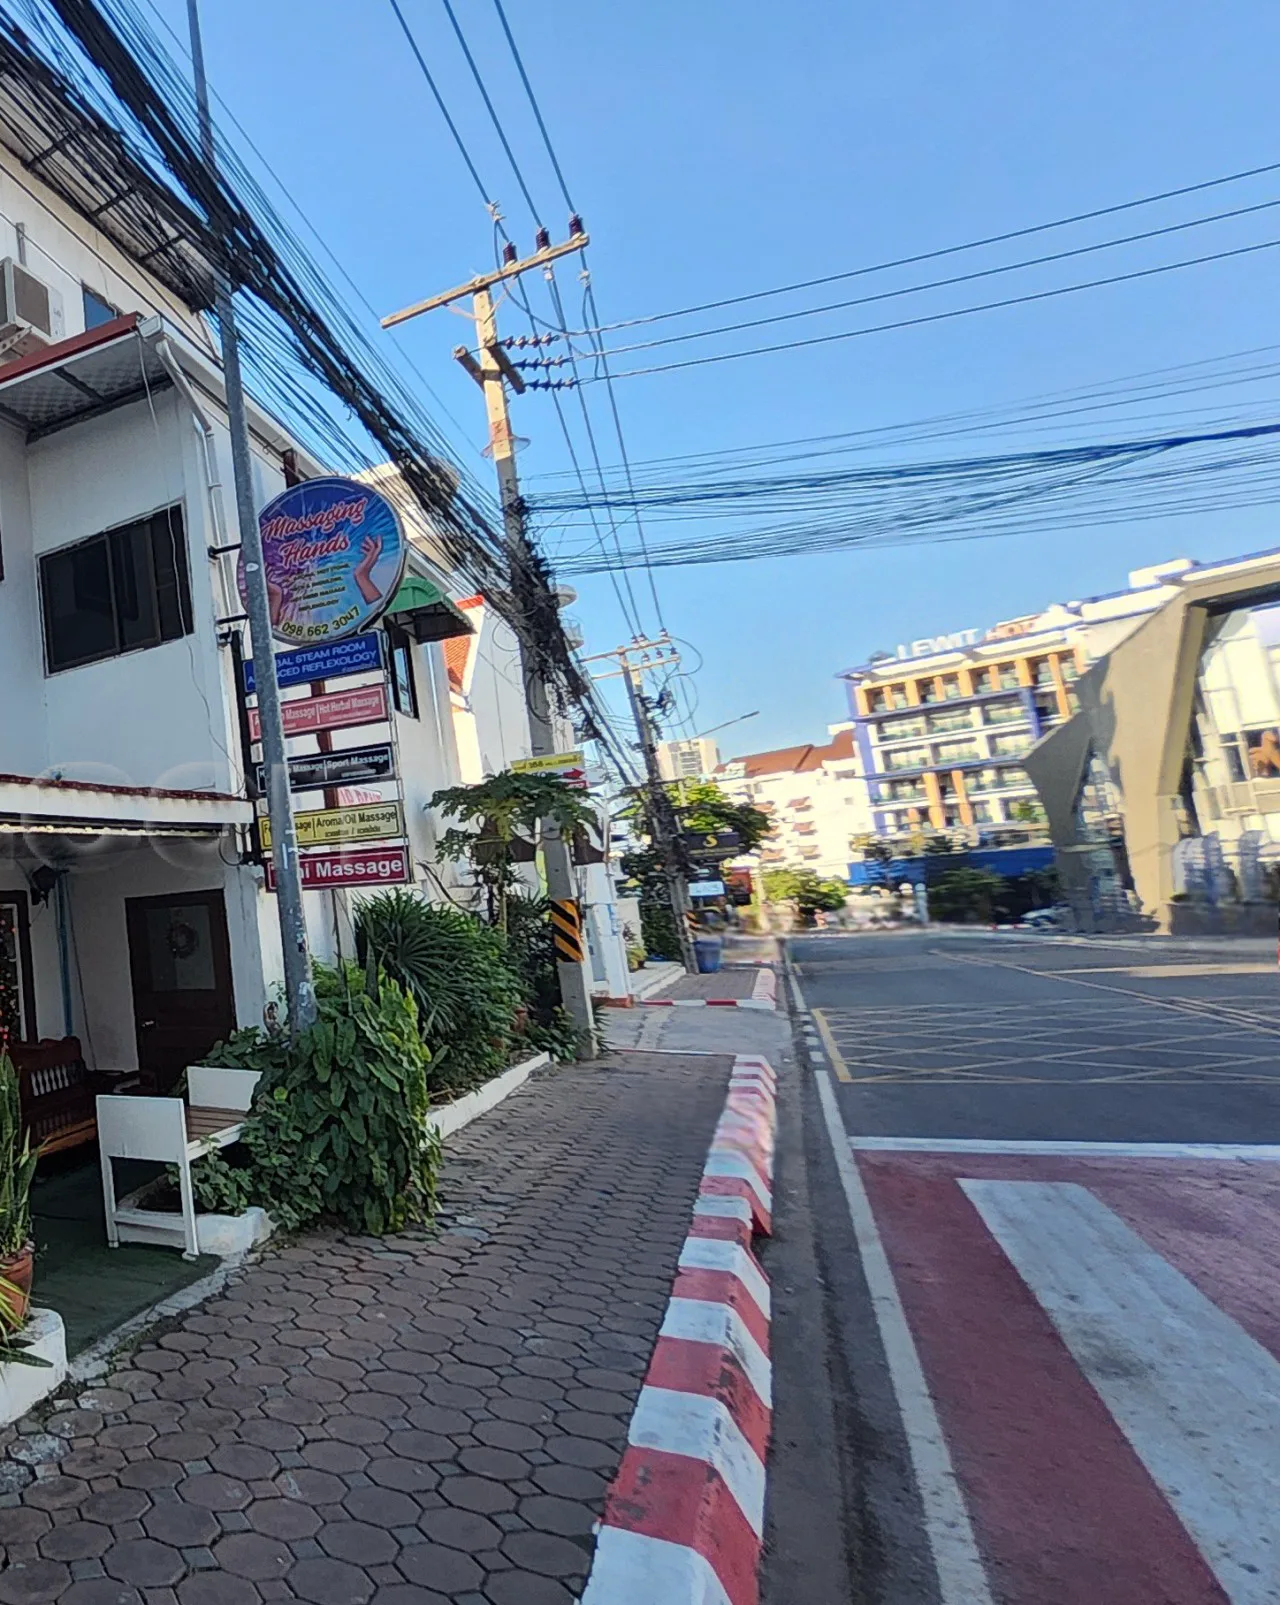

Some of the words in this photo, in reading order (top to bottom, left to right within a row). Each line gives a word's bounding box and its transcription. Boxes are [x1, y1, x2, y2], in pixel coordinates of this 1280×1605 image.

[261, 496, 368, 540] Massaging
[278, 533, 351, 568] Hands
[281, 621, 303, 637] 098
[306, 622, 330, 637] 662
[333, 605, 361, 632] 3047
[295, 649, 331, 663] STEAM
[332, 640, 366, 656] ROOM
[301, 650, 377, 674] REFLEXOLOGY
[326, 758, 350, 770] Sport
[350, 753, 389, 766] Massage
[358, 809, 397, 824] Massage
[315, 859, 403, 879] Massage
